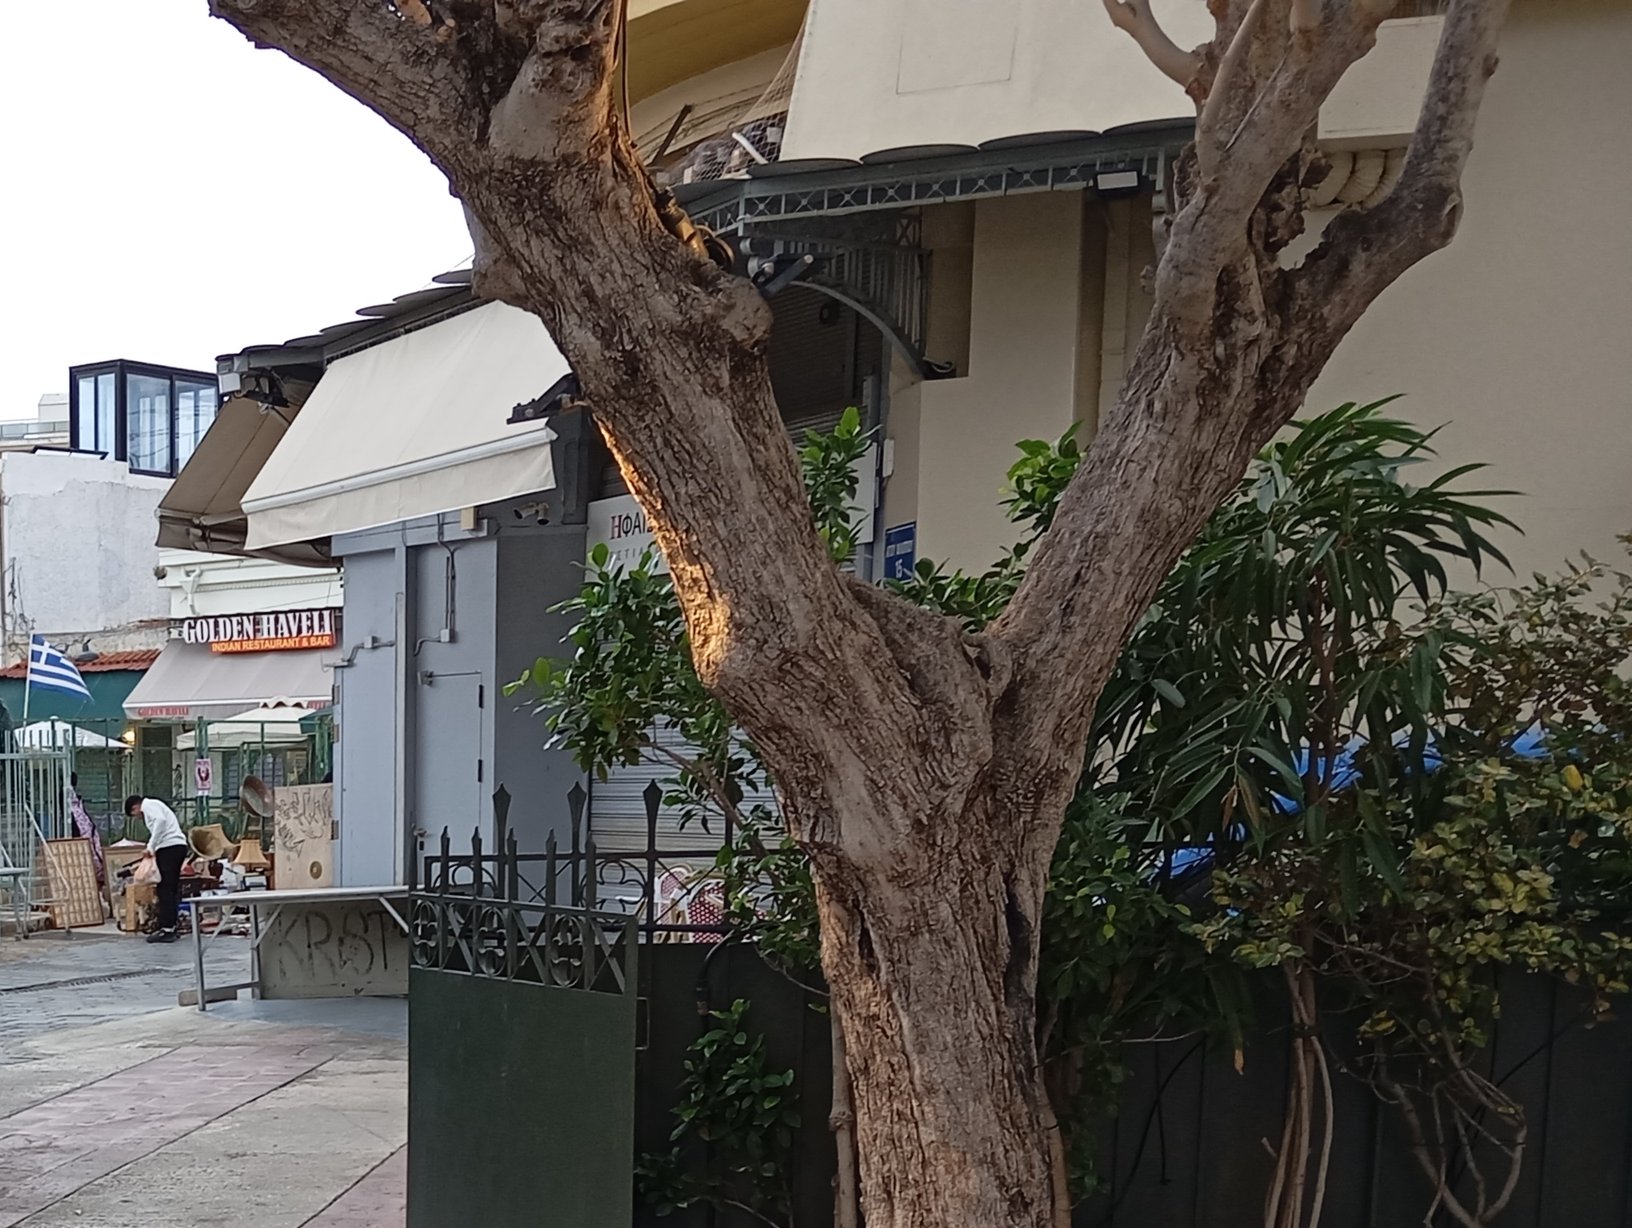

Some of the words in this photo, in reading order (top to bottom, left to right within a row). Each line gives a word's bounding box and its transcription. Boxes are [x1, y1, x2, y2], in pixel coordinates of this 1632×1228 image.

[183, 615, 255, 644] GOLDEN
[262, 609, 332, 639] HAVELI
[212, 642, 241, 652] INDIAN
[242, 638, 301, 650] RESTAURANT
[302, 637, 309, 647] &
[310, 636, 330, 646] BAR
